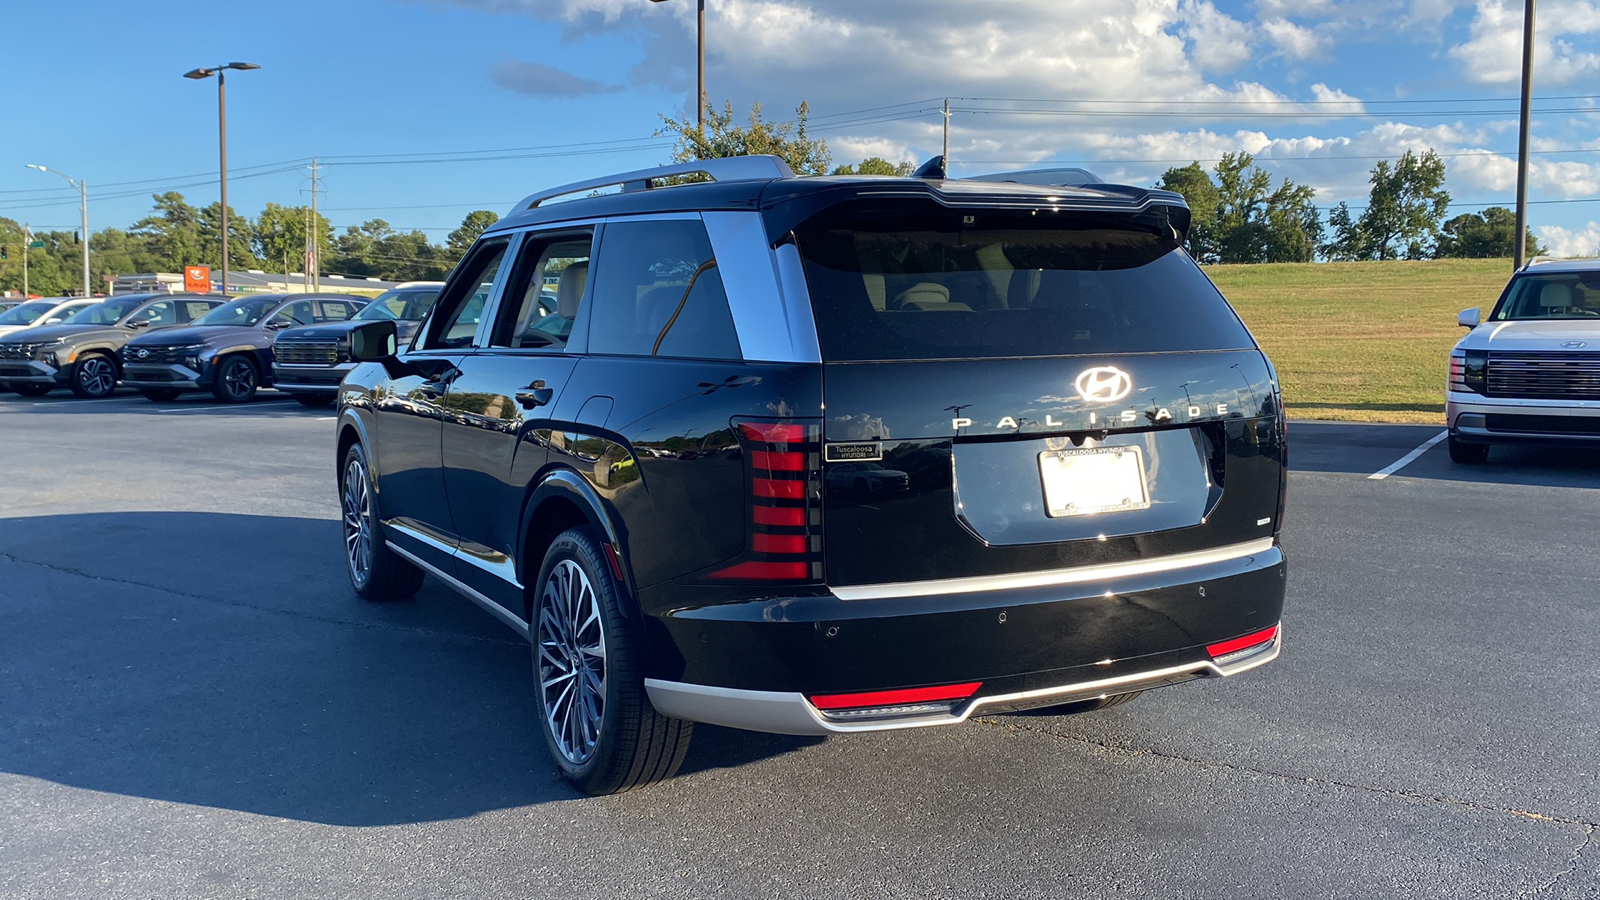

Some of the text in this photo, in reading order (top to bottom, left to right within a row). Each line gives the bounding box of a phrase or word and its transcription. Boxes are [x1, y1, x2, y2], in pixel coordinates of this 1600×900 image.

[952, 404, 1228, 430] PALISADE
[835, 445, 873, 453] Tuscaloosa
[1057, 448, 1097, 457] TUSCALOOSA
